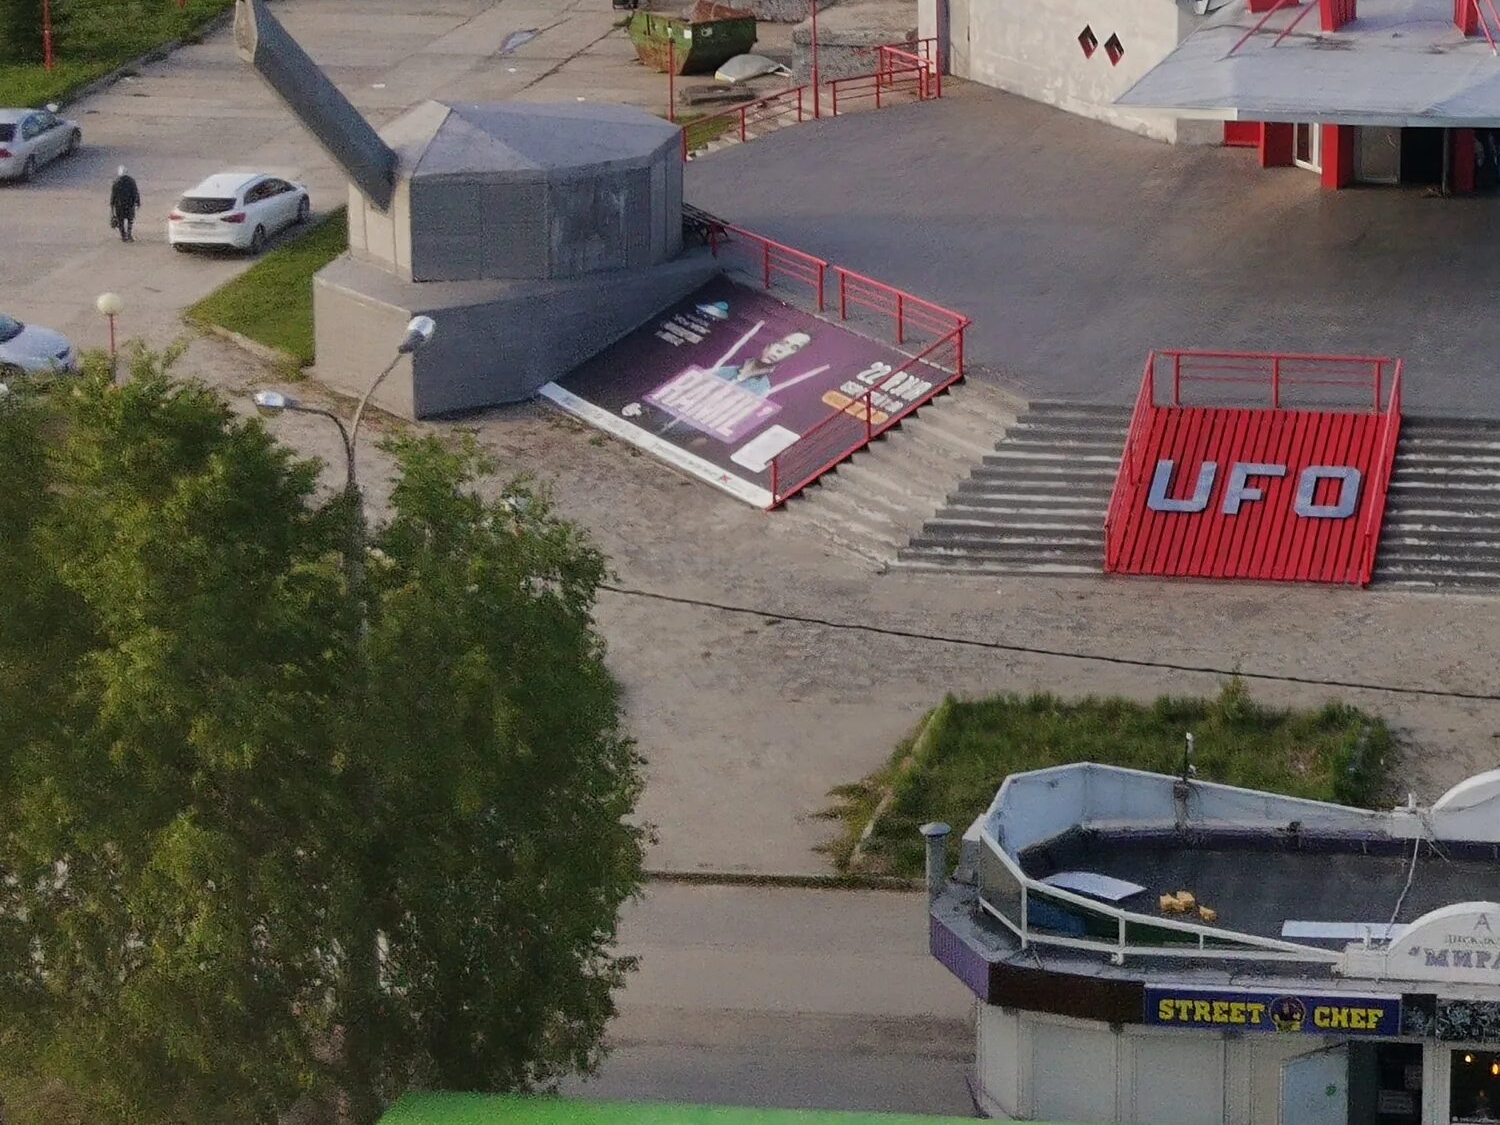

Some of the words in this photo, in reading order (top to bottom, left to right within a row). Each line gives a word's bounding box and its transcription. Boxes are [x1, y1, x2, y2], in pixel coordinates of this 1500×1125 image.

[1147, 459, 1362, 519] UFO
[1159, 999, 1265, 1023] STREET
[1314, 1006, 1384, 1029] CHEF
